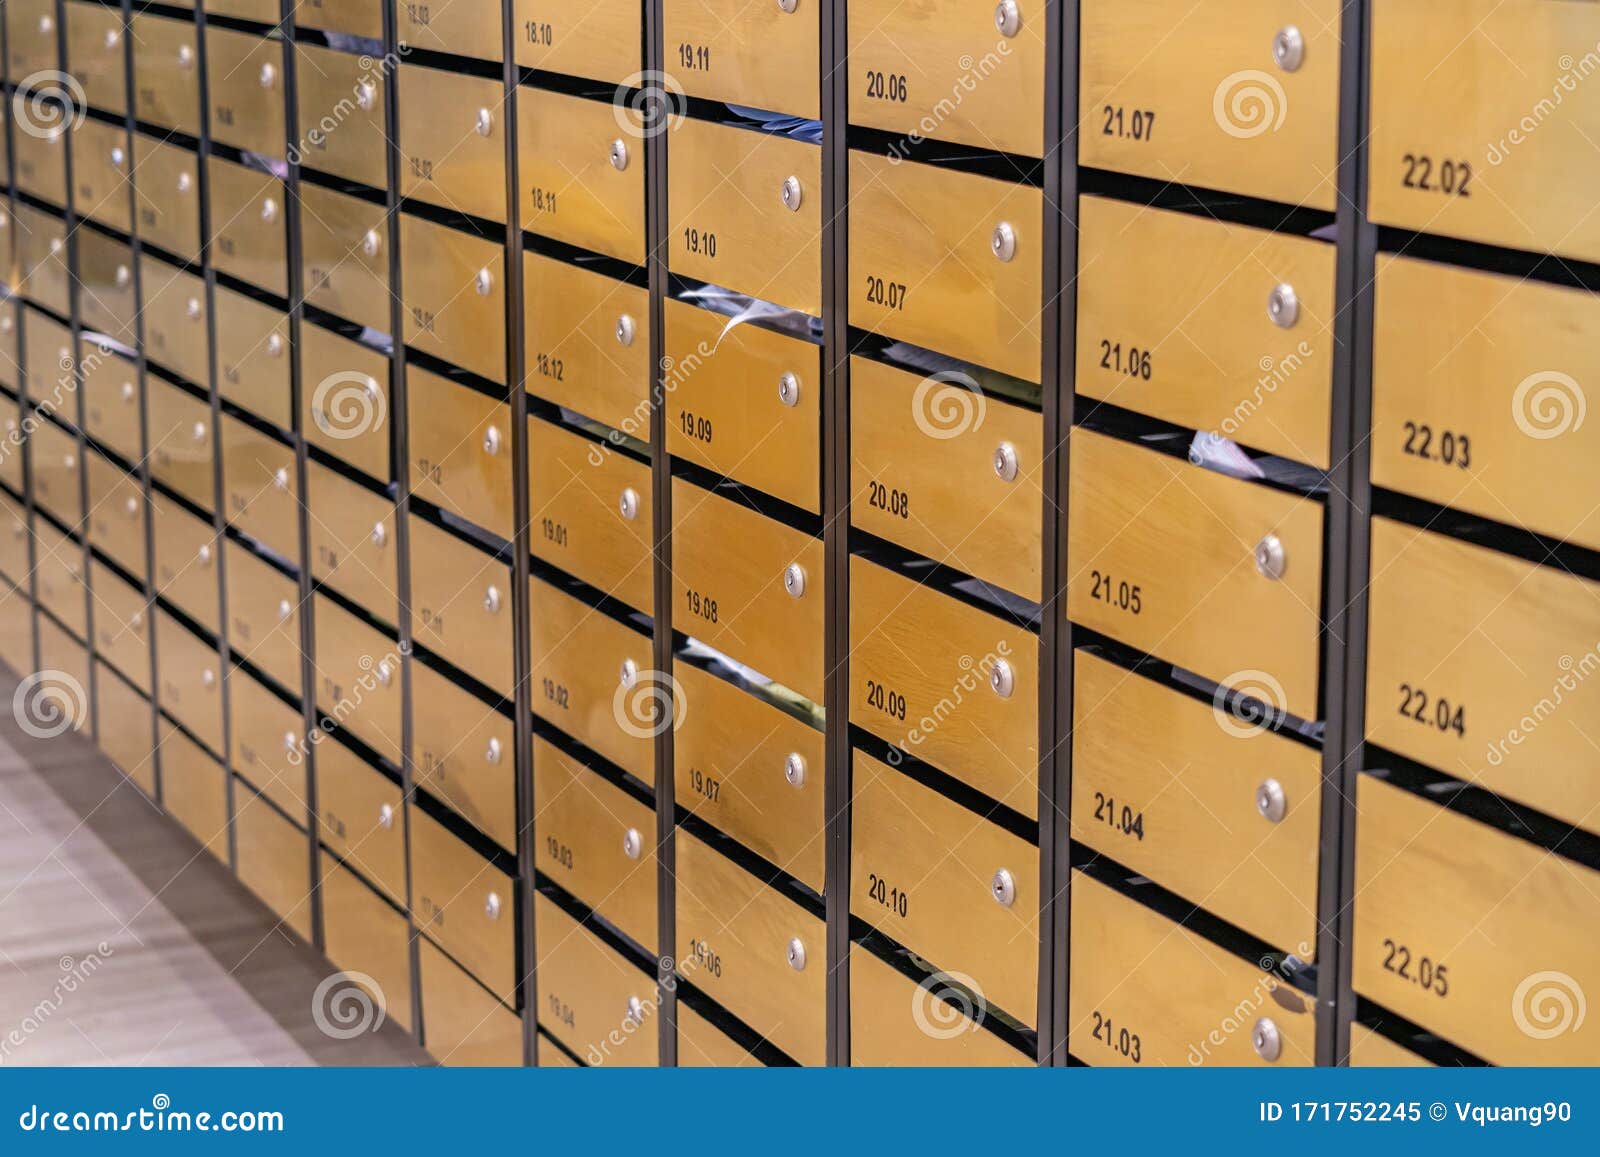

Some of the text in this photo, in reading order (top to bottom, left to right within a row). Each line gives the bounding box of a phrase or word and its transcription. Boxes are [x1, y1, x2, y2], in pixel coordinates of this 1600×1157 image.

[525, 20, 552, 46] 18.10
[679, 44, 710, 72] 19.11
[866, 71, 907, 103] 20.06
[1103, 105, 1155, 142] 21.07
[1401, 153, 1473, 198] 22.02
[531, 188, 557, 215] 18.11
[684, 228, 716, 258] 19.10
[866, 276, 906, 311] 20.07
[537, 352, 563, 382] 18.12
[1100, 340, 1152, 381] 21.06
[680, 411, 712, 443] 19.09
[1402, 422, 1472, 470] 22.03
[869, 480, 909, 520] 20.08
[542, 518, 567, 548] 19.01
[686, 589, 718, 624] 19.08
[1090, 571, 1142, 615] 21.05
[542, 677, 569, 709] 19.02
[867, 680, 906, 721] 20.09
[1399, 684, 1467, 738] 22.04
[689, 768, 720, 803] 19.07
[1094, 792, 1144, 842] 21.04
[547, 837, 573, 870] 19.03
[869, 874, 907, 918] 20.10
[690, 938, 722, 979] 19.06
[1382, 938, 1449, 998] 22.05
[549, 994, 575, 1029] 19.04
[1092, 1011, 1141, 1064] 21.03
